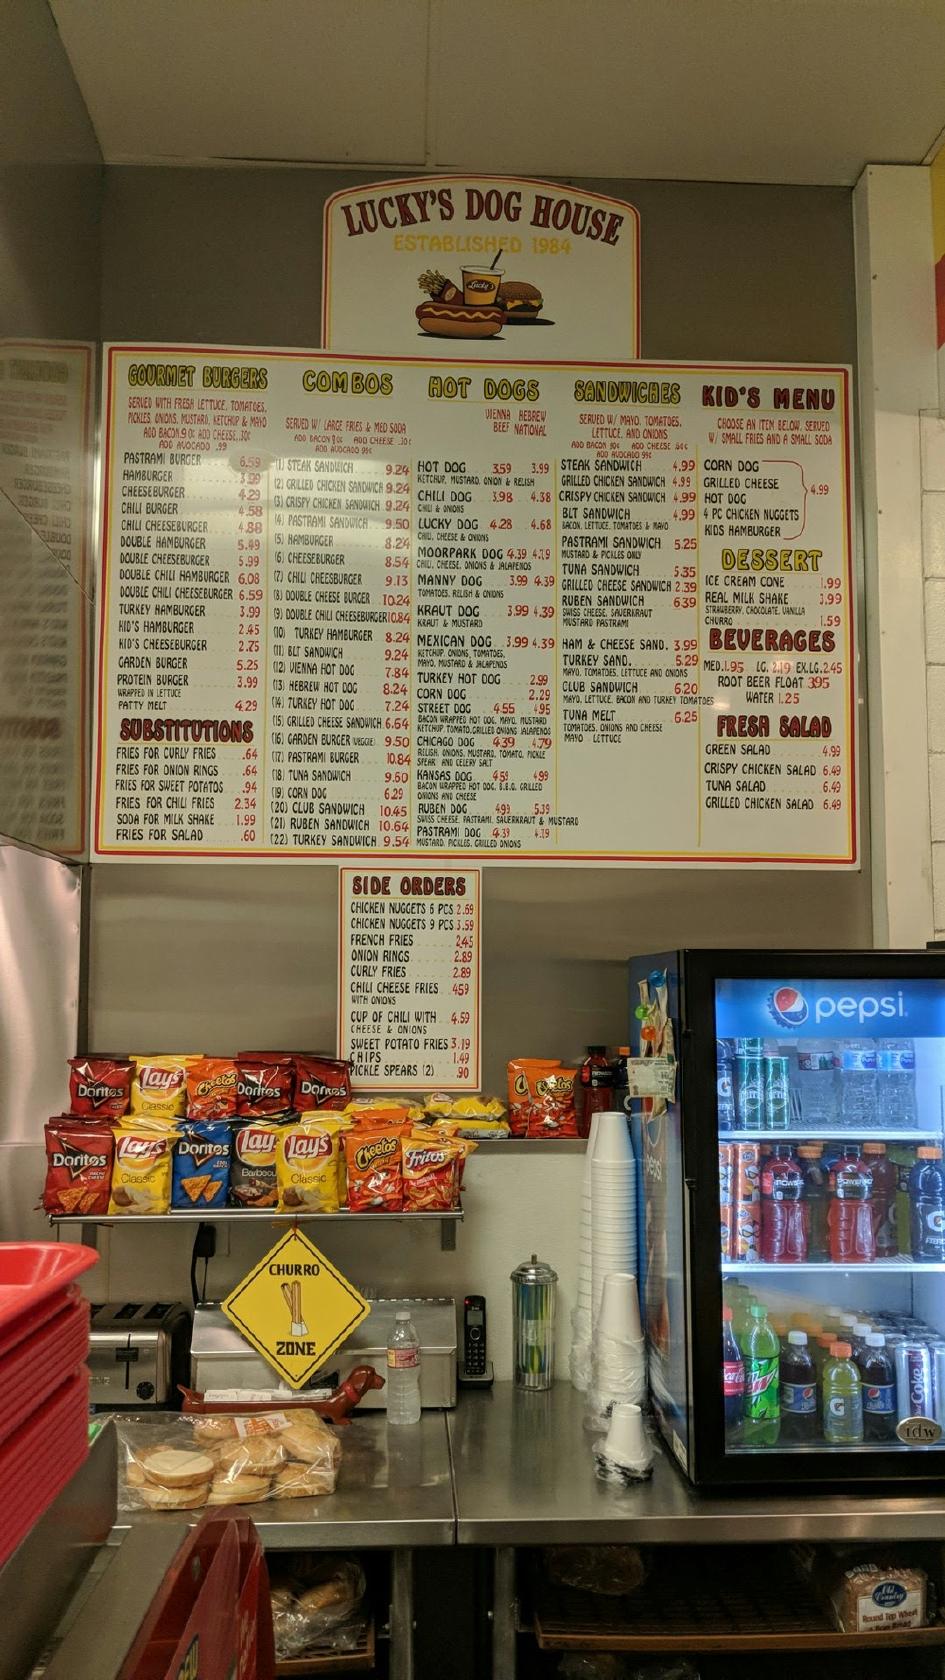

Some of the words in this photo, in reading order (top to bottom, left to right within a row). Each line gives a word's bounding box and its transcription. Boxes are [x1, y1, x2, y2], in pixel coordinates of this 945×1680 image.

[341, 188, 455, 236] LUCKY'S
[465, 189, 522, 221] DOG
[530, 194, 624, 246] HOUSE
[393, 235, 522, 253] ESTABLISHED
[531, 238, 572, 255] 1984
[128, 364, 195, 387] GOURMET
[203, 366, 268, 389] BURGERS
[302, 370, 393, 395] COMBOS
[428, 376, 471, 398] HOT
[484, 378, 540, 401] DOGS
[574, 380, 681, 404] SANDWICHES
[702, 385, 761, 408] KID'S
[774, 388, 835, 410] MENU
[718, 418, 744, 429] CHOOSE
[747, 419, 756, 430] AN
[759, 420, 774, 431] ITEM
[805, 421, 830, 432] SERVED
[561, 459, 590, 470] STEAK
[595, 460, 642, 471] SANDWICH
[672, 460, 695, 471] 4.99
[704, 460, 732, 471] CORN
[738, 461, 759, 472] DOG
[704, 478, 740, 489] GRILLED
[745, 479, 779, 489] CHEESE
[810, 485, 829, 495] 4.99
[418, 490, 445, 502] CHILI
[451, 490, 472, 502] DOG
[531, 492, 551, 502] 4.38
[705, 493, 723, 504] HOT
[728, 494, 747, 504] DOG
[713, 509, 723, 519] PC
[726, 509, 760, 520] CHICKEN
[764, 509, 799, 520] NUGGETS
[418, 518, 451, 529] LUCKY
[458, 519, 478, 530] DOG
[489, 519, 512, 530] 4.28
[531, 519, 551, 530] 4.68
[705, 525, 724, 536] KIDS
[729, 526, 781, 537] HAMBURGER
[722, 549, 823, 571] DESSERT
[563, 564, 586, 575] TUNA
[592, 564, 639, 576] SANDWICH
[674, 567, 696, 577] 5.35
[119, 605, 150, 615] TURKEY
[155, 605, 206, 617] HAMBURGER
[240, 607, 260, 618] 3.99
[709, 628, 835, 652] BEVERAGES
[119, 657, 151, 669] GARDEN
[156, 658, 188, 669] BURGER
[237, 660, 259, 670] 5.25
[290, 662, 317, 675] VIENNA
[321, 663, 336, 675] HOT
[339, 664, 354, 676] DOG
[385, 667, 409, 678] 7.84
[562, 681, 585, 692] CLUB
[591, 682, 638, 693] SANDWICH
[675, 683, 698, 694] 6.20
[120, 718, 253, 743] SUBSTITUTIONS
[717, 715, 770, 737] FRESH
[779, 716, 831, 738] SALAD
[117, 747, 139, 759] FRIES
[143, 748, 159, 759] FOR
[164, 748, 189, 759] CURLY
[193, 748, 216, 759] FRIES
[242, 748, 258, 760] .64
[706, 744, 736, 755] GREEN
[741, 744, 770, 755] SALAD
[823, 746, 840, 757] 4.99
[706, 780, 731, 791] TUNA
[736, 781, 765, 792] SALAD
[271, 802, 288, 814] (20)
[292, 803, 314, 814] CLUB
[319, 803, 365, 815] SANDWICH
[352, 876, 391, 896] SIDE
[401, 877, 466, 896] ORDERS
[351, 902, 385, 914] CHICKEN
[389, 903, 426, 915] NUGGETS
[439, 904, 453, 915] PCS
[351, 918, 385, 929] CHICKEN
[389, 919, 426, 930] NUGGETS
[430, 919, 435, 930] 9
[439, 919, 454, 931] PCS
[351, 934, 385, 946] FRENCH
[389, 935, 413, 946] FRIES
[351, 950, 379, 962] ONION
[383, 950, 410, 962] RINGS
[454, 951, 473, 962] 2.89
[351, 966, 378, 977] CURLY
[382, 966, 406, 977] FRIES
[453, 967, 471, 978] 2.89
[351, 982, 373, 994] CHILI
[377, 982, 410, 994] CHEESE
[415, 983, 438, 994] FRIES
[371, 997, 396, 1005] ONIONS
[816, 991, 904, 1024] pepsi
[351, 1011, 369, 1022] CUP
[372, 1011, 383, 1022] OF
[387, 1012, 410, 1023] CHILI
[415, 1011, 437, 1023] WITH
[451, 1012, 470, 1024] 4.59
[351, 1025, 381, 1033] CHEESE
[387, 1025, 392, 1033] &
[398, 1025, 427, 1034] ONIONS
[351, 1039, 380, 1050] SWEET
[385, 1039, 419, 1050] POTATO
[424, 1039, 448, 1050] FRIES
[451, 1039, 470, 1050] 3.19
[350, 1052, 381, 1063] CHIPS
[453, 1053, 469, 1064] 1.49
[384, 1065, 417, 1076] SPEARS
[423, 1065, 434, 1076] (2)
[456, 1067, 469, 1079] .90
[78, 1085, 123, 1097] Doritos
[197, 1074, 237, 1096] Cheetos
[238, 1083, 280, 1097] Doritos
[302, 1082, 346, 1096] Doritos
[142, 1102, 174, 1111] Classic
[179, 1142, 229, 1155] Doritos
[356, 1139, 397, 1169] Cheetos
[53, 1154, 106, 1166] Doritos
[406, 1149, 445, 1168] Fritos
[121, 1174, 156, 1183] Classic
[242, 1168, 276, 1177] Barbecu
[291, 1174, 326, 1183] Classic
[269, 1264, 320, 1276] CHURRO
[277, 1342, 316, 1356] ZONE
[911, 1369, 923, 1403] Coke
